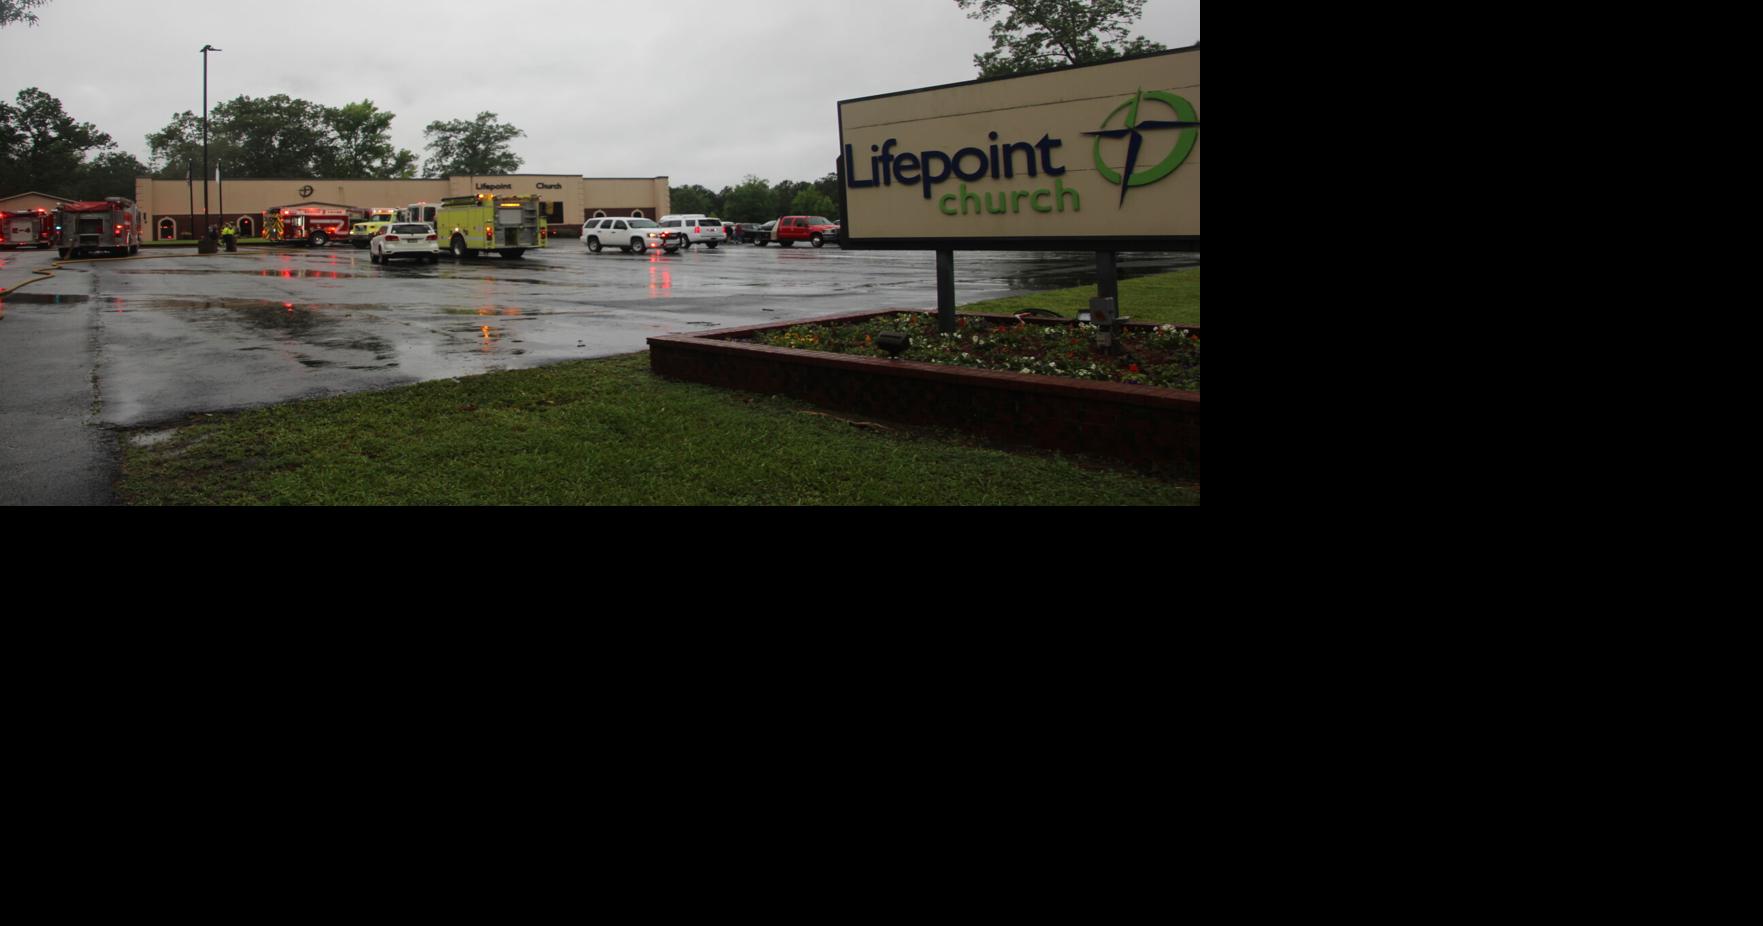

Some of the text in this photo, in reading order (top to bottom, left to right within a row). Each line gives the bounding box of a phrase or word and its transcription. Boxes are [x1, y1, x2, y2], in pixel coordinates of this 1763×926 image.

[844, 130, 1067, 200] Lifepoint
[475, 182, 562, 191] Lifepoint Church
[938, 178, 1081, 216] church
